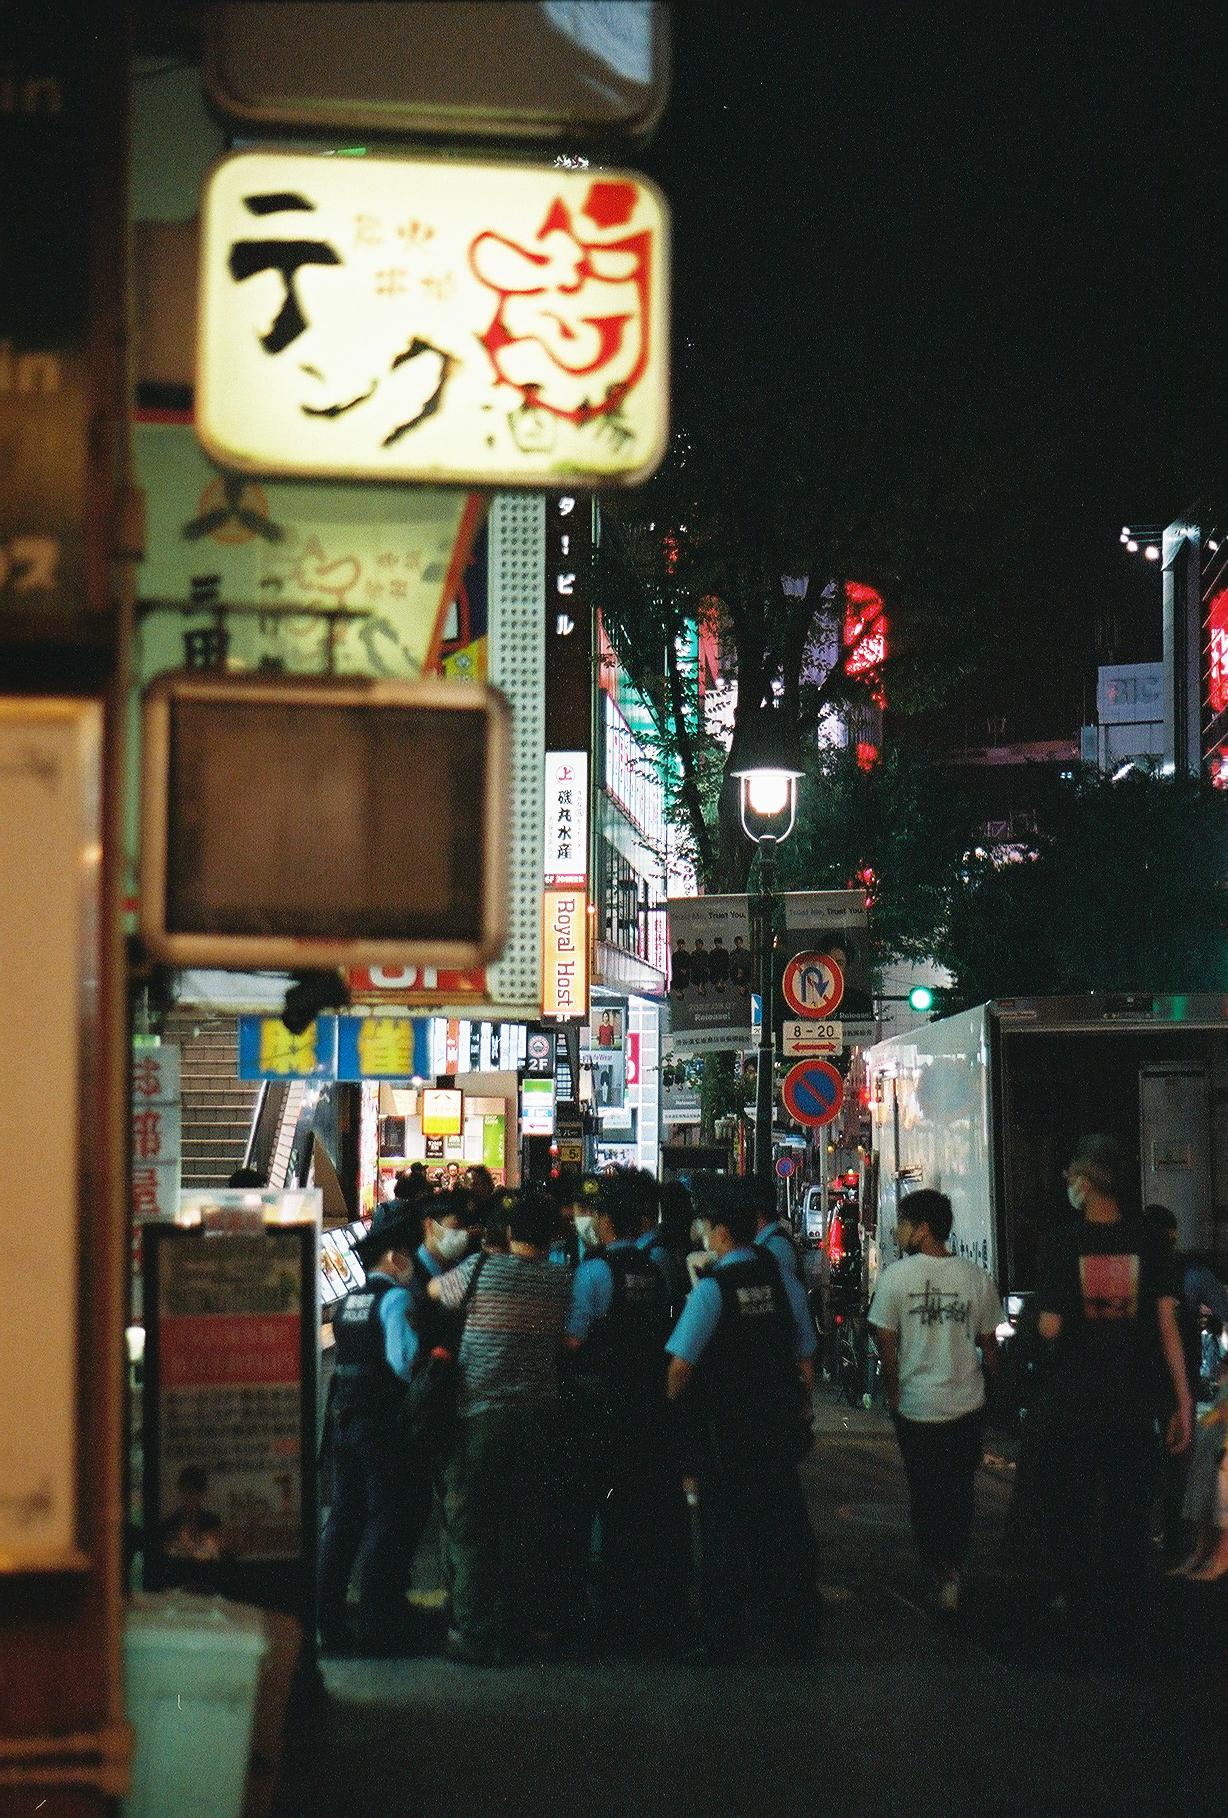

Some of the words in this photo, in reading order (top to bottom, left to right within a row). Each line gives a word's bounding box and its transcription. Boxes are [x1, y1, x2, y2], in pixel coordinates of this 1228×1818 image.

[557, 789, 573, 860] 磯丸水産
[553, 898, 576, 952] Royal
[556, 960, 575, 1007] Host
[528, 1058, 549, 1071] 2F
